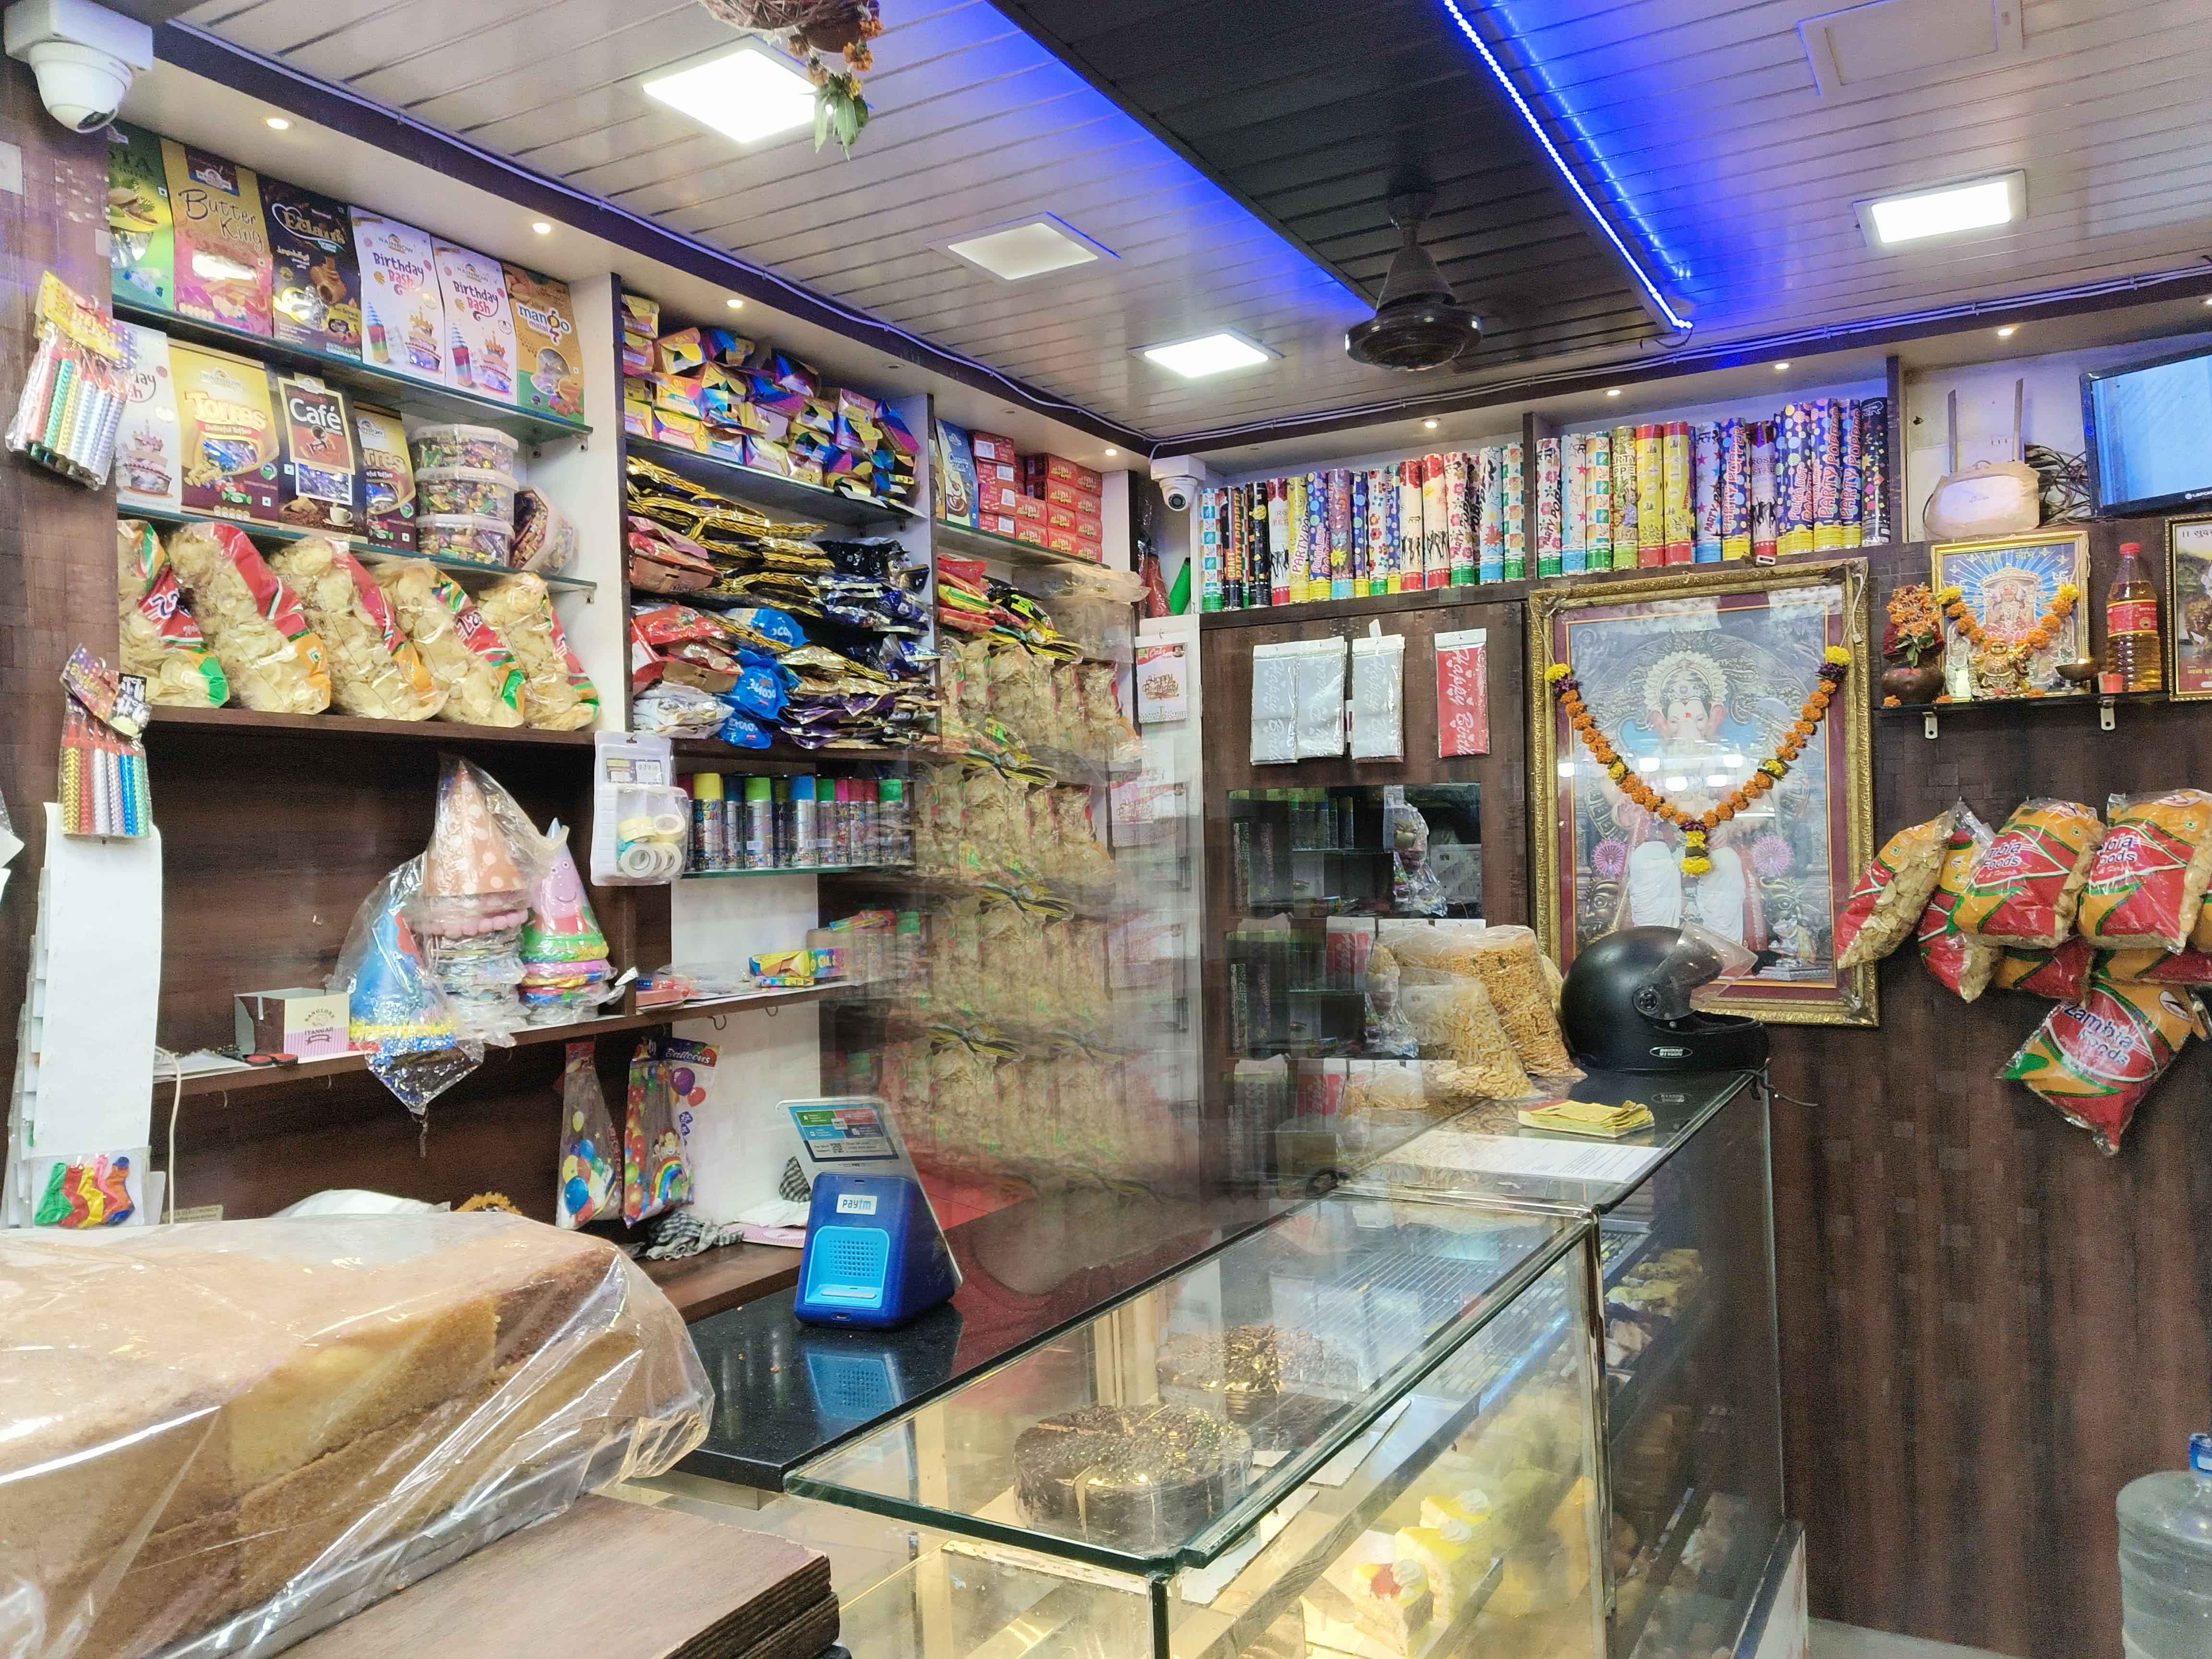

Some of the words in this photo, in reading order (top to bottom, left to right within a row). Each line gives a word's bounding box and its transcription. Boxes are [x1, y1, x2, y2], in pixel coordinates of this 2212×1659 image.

[178, 189, 256, 225] Butter
[219, 217, 264, 252] King
[373, 252, 424, 279] Birthday
[387, 269, 415, 288] Bash
[453, 280, 499, 307] Birthday
[466, 297, 490, 313] Bash
[184, 391, 268, 430] Torres
[289, 398, 341, 430] Café
[1827, 407, 1840, 466] POPPER
[1795, 468, 1807, 486] DOT
[1818, 467, 1837, 517] PARTY
[1840, 468, 1859, 518] PARTY
[1704, 505, 1717, 532] PARTY
[1788, 488, 1804, 520] POLKA
[1543, 519, 1555, 546] PARTY
[1292, 534, 1308, 573] PARTY
[1448, 649, 1470, 706] Happy
[1456, 711, 1474, 756] Birth
[2065, 1005, 2134, 1048] Zambia
[666, 1048, 711, 1064] Balloons
[2078, 1028, 2128, 1066] Foods
[842, 1199, 871, 1210] paytm
